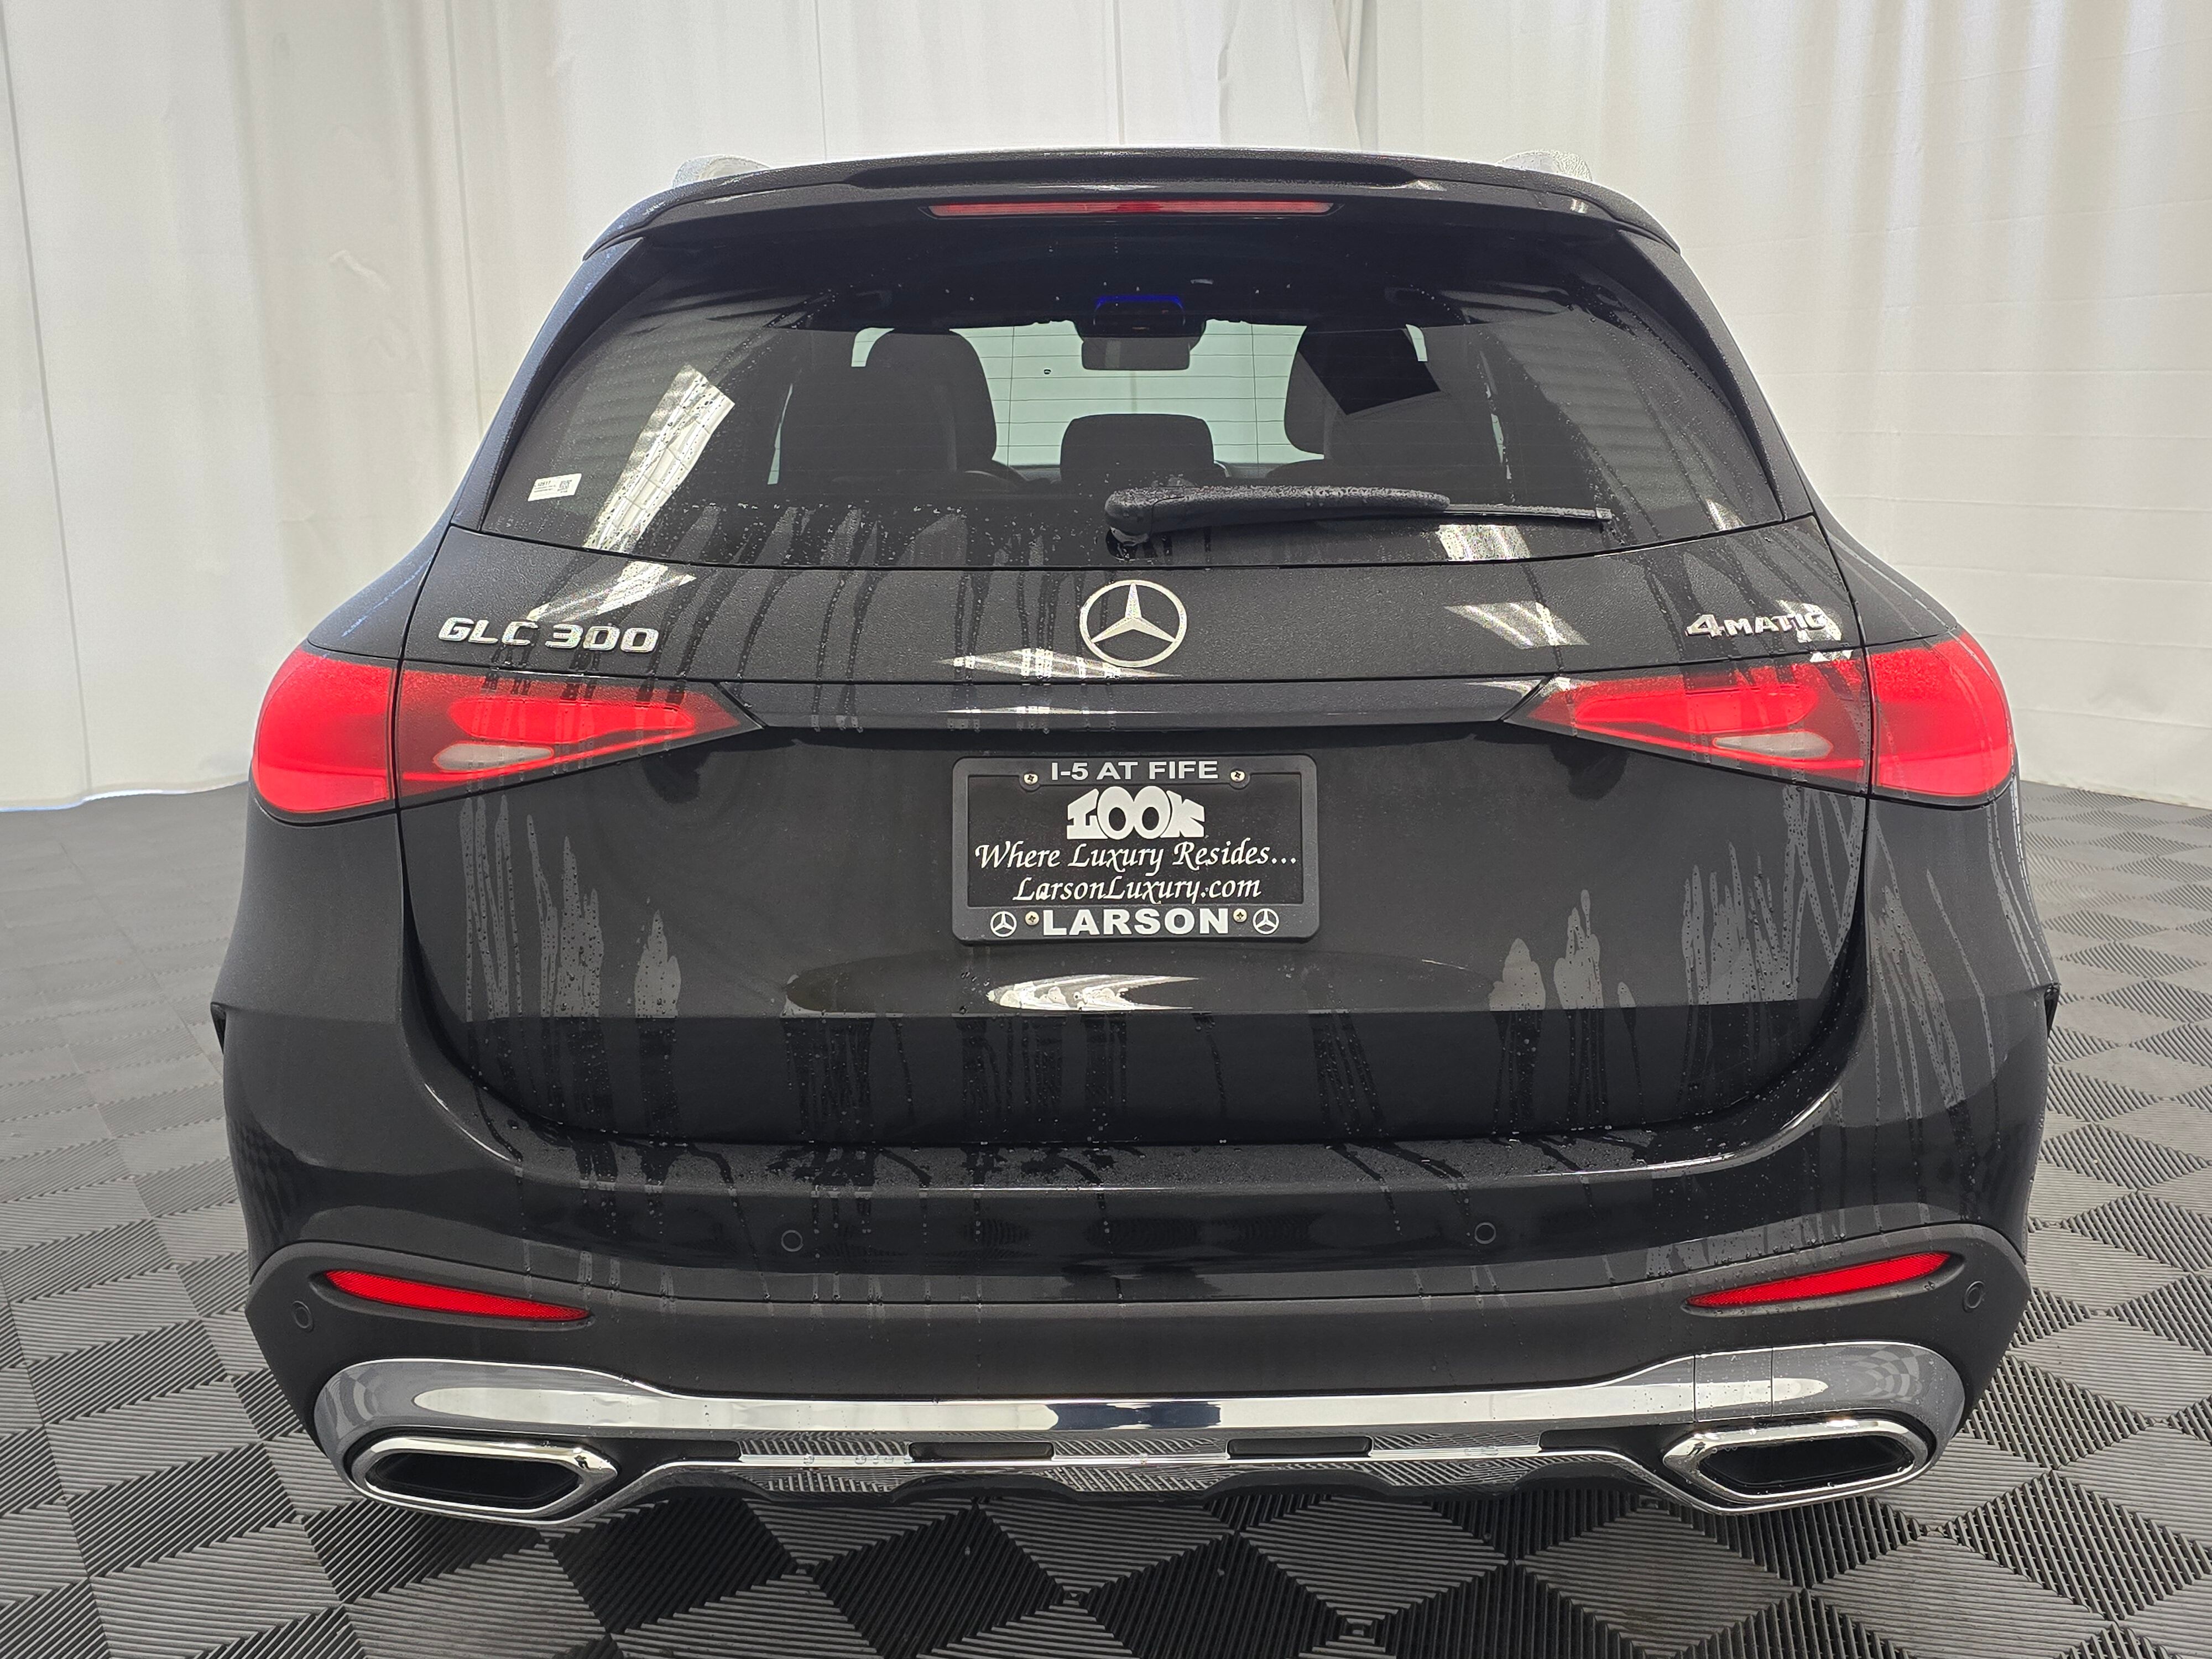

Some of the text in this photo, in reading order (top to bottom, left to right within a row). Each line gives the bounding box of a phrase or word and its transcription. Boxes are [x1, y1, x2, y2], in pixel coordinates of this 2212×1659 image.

[439, 617, 659, 653] GLC 300
[1686, 613, 1827, 638] 4MATIC
[1051, 761, 1218, 780] I-5 AT FIFE
[974, 837, 1297, 877] Where Luxury Resides...
[1012, 875, 1261, 904] LarsonLuxury.com
[1043, 908, 1229, 936] LARSON
